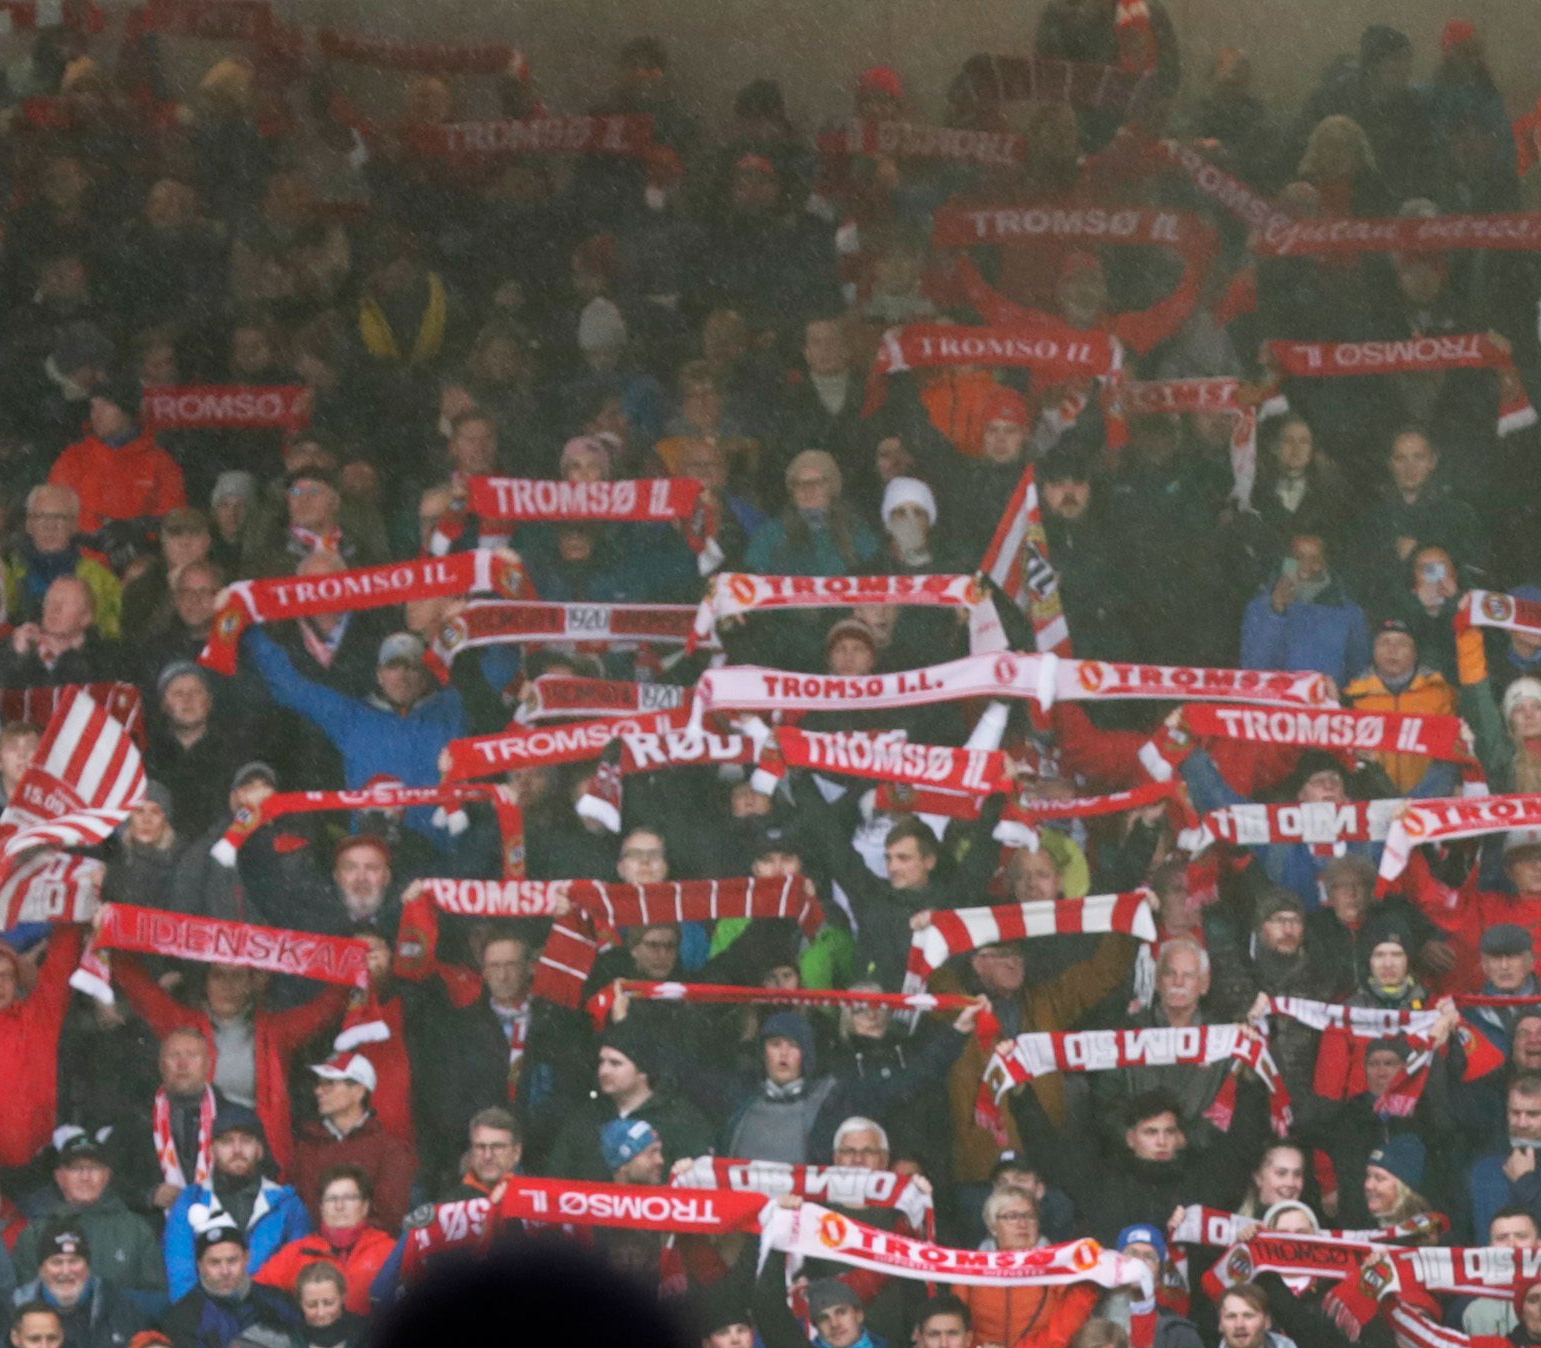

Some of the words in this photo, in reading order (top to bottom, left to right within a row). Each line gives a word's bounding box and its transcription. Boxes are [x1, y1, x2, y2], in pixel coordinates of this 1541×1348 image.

[151, 392, 284, 421] ROMSØ
[487, 476, 637, 515] TROMSØ
[271, 567, 414, 607] TROMSØ
[423, 562, 458, 583] IL
[762, 675, 884, 700] TROMSØ
[896, 671, 944, 695] I.L.
[1215, 708, 1386, 748] TROMSØ
[800, 730, 955, 781] TROMSØ
[423, 879, 574, 915] ROMSØ
[112, 913, 369, 977] LIDENSKAP
[558, 1191, 721, 1224] TROMSØ
[859, 1226, 1056, 1269] TROMSØ
